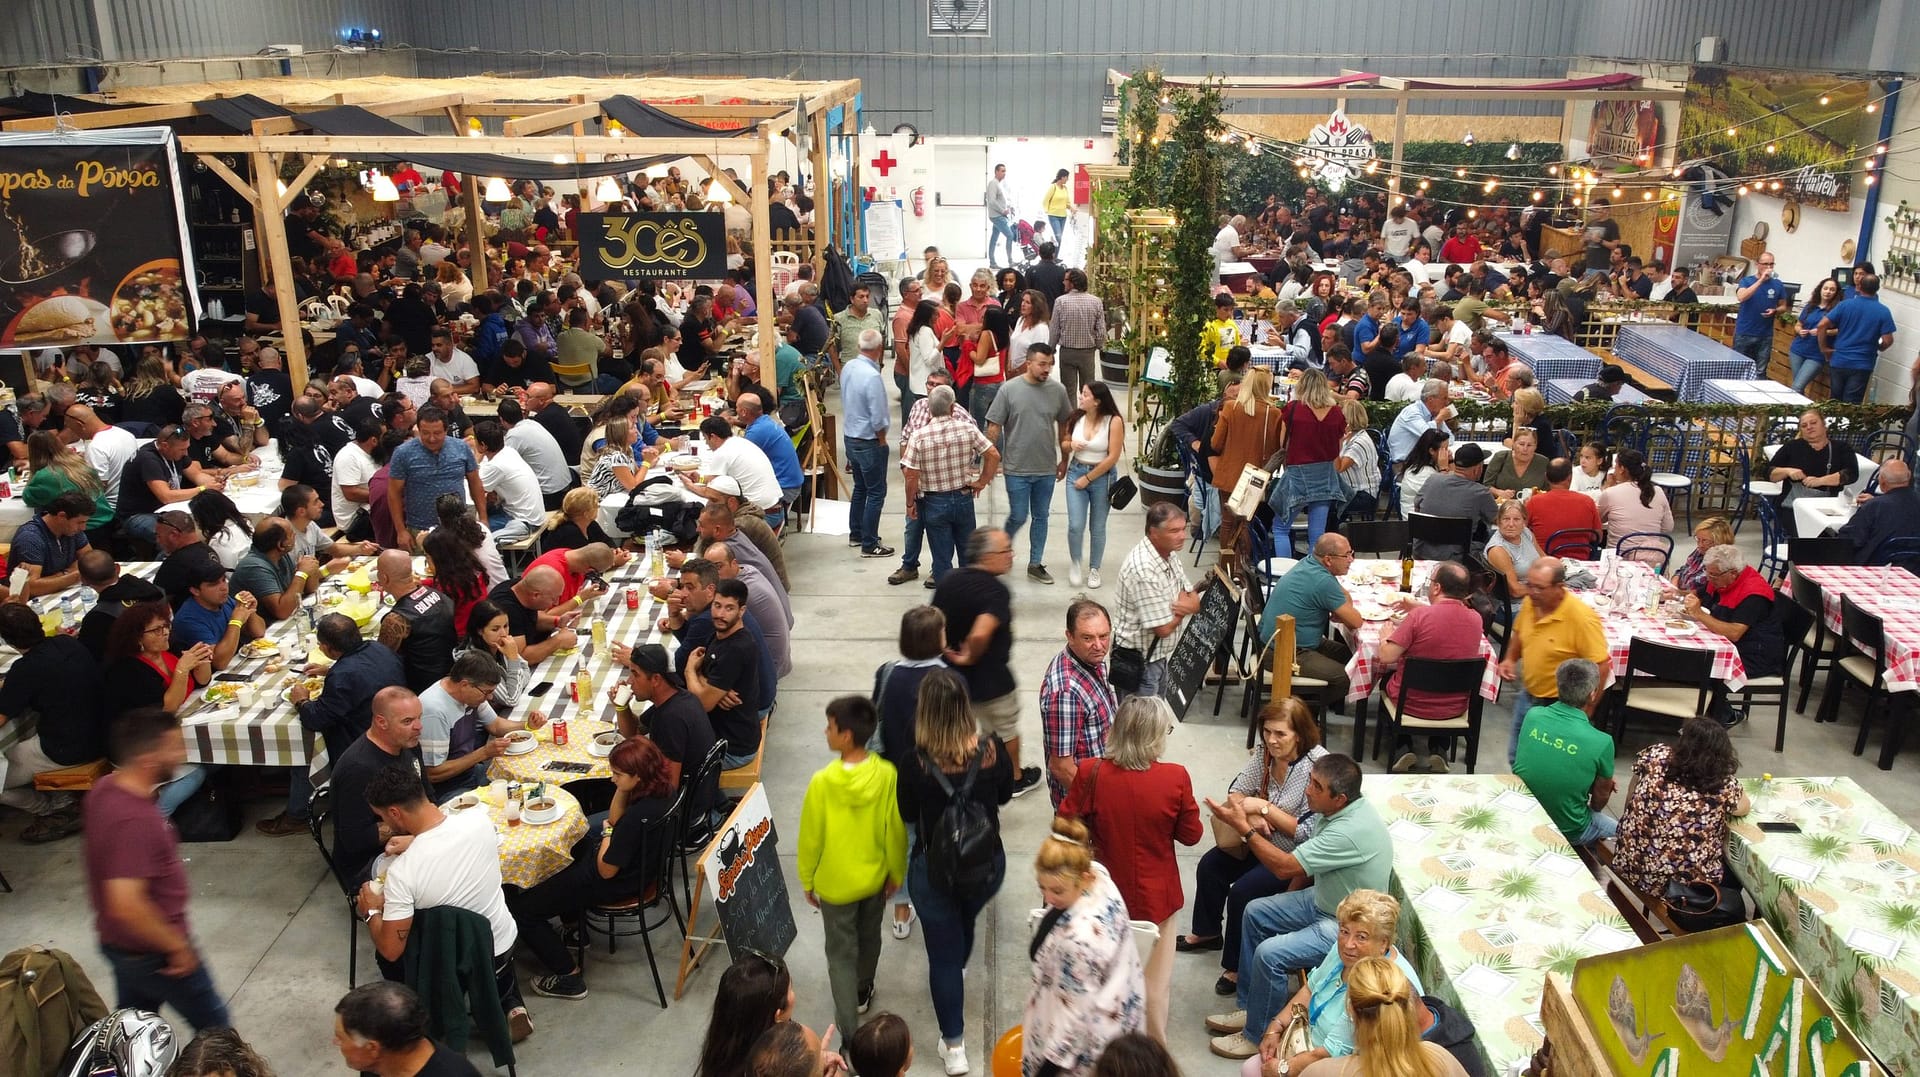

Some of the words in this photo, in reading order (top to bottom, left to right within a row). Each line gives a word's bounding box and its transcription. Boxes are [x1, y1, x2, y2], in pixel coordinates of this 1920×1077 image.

[0, 168, 54, 199] pas
[56, 174, 76, 190] da
[75, 160, 160, 198] Póvoa
[623, 269, 688, 277] RESTAURANTE
[1529, 727, 1579, 755] A.L.S.C
